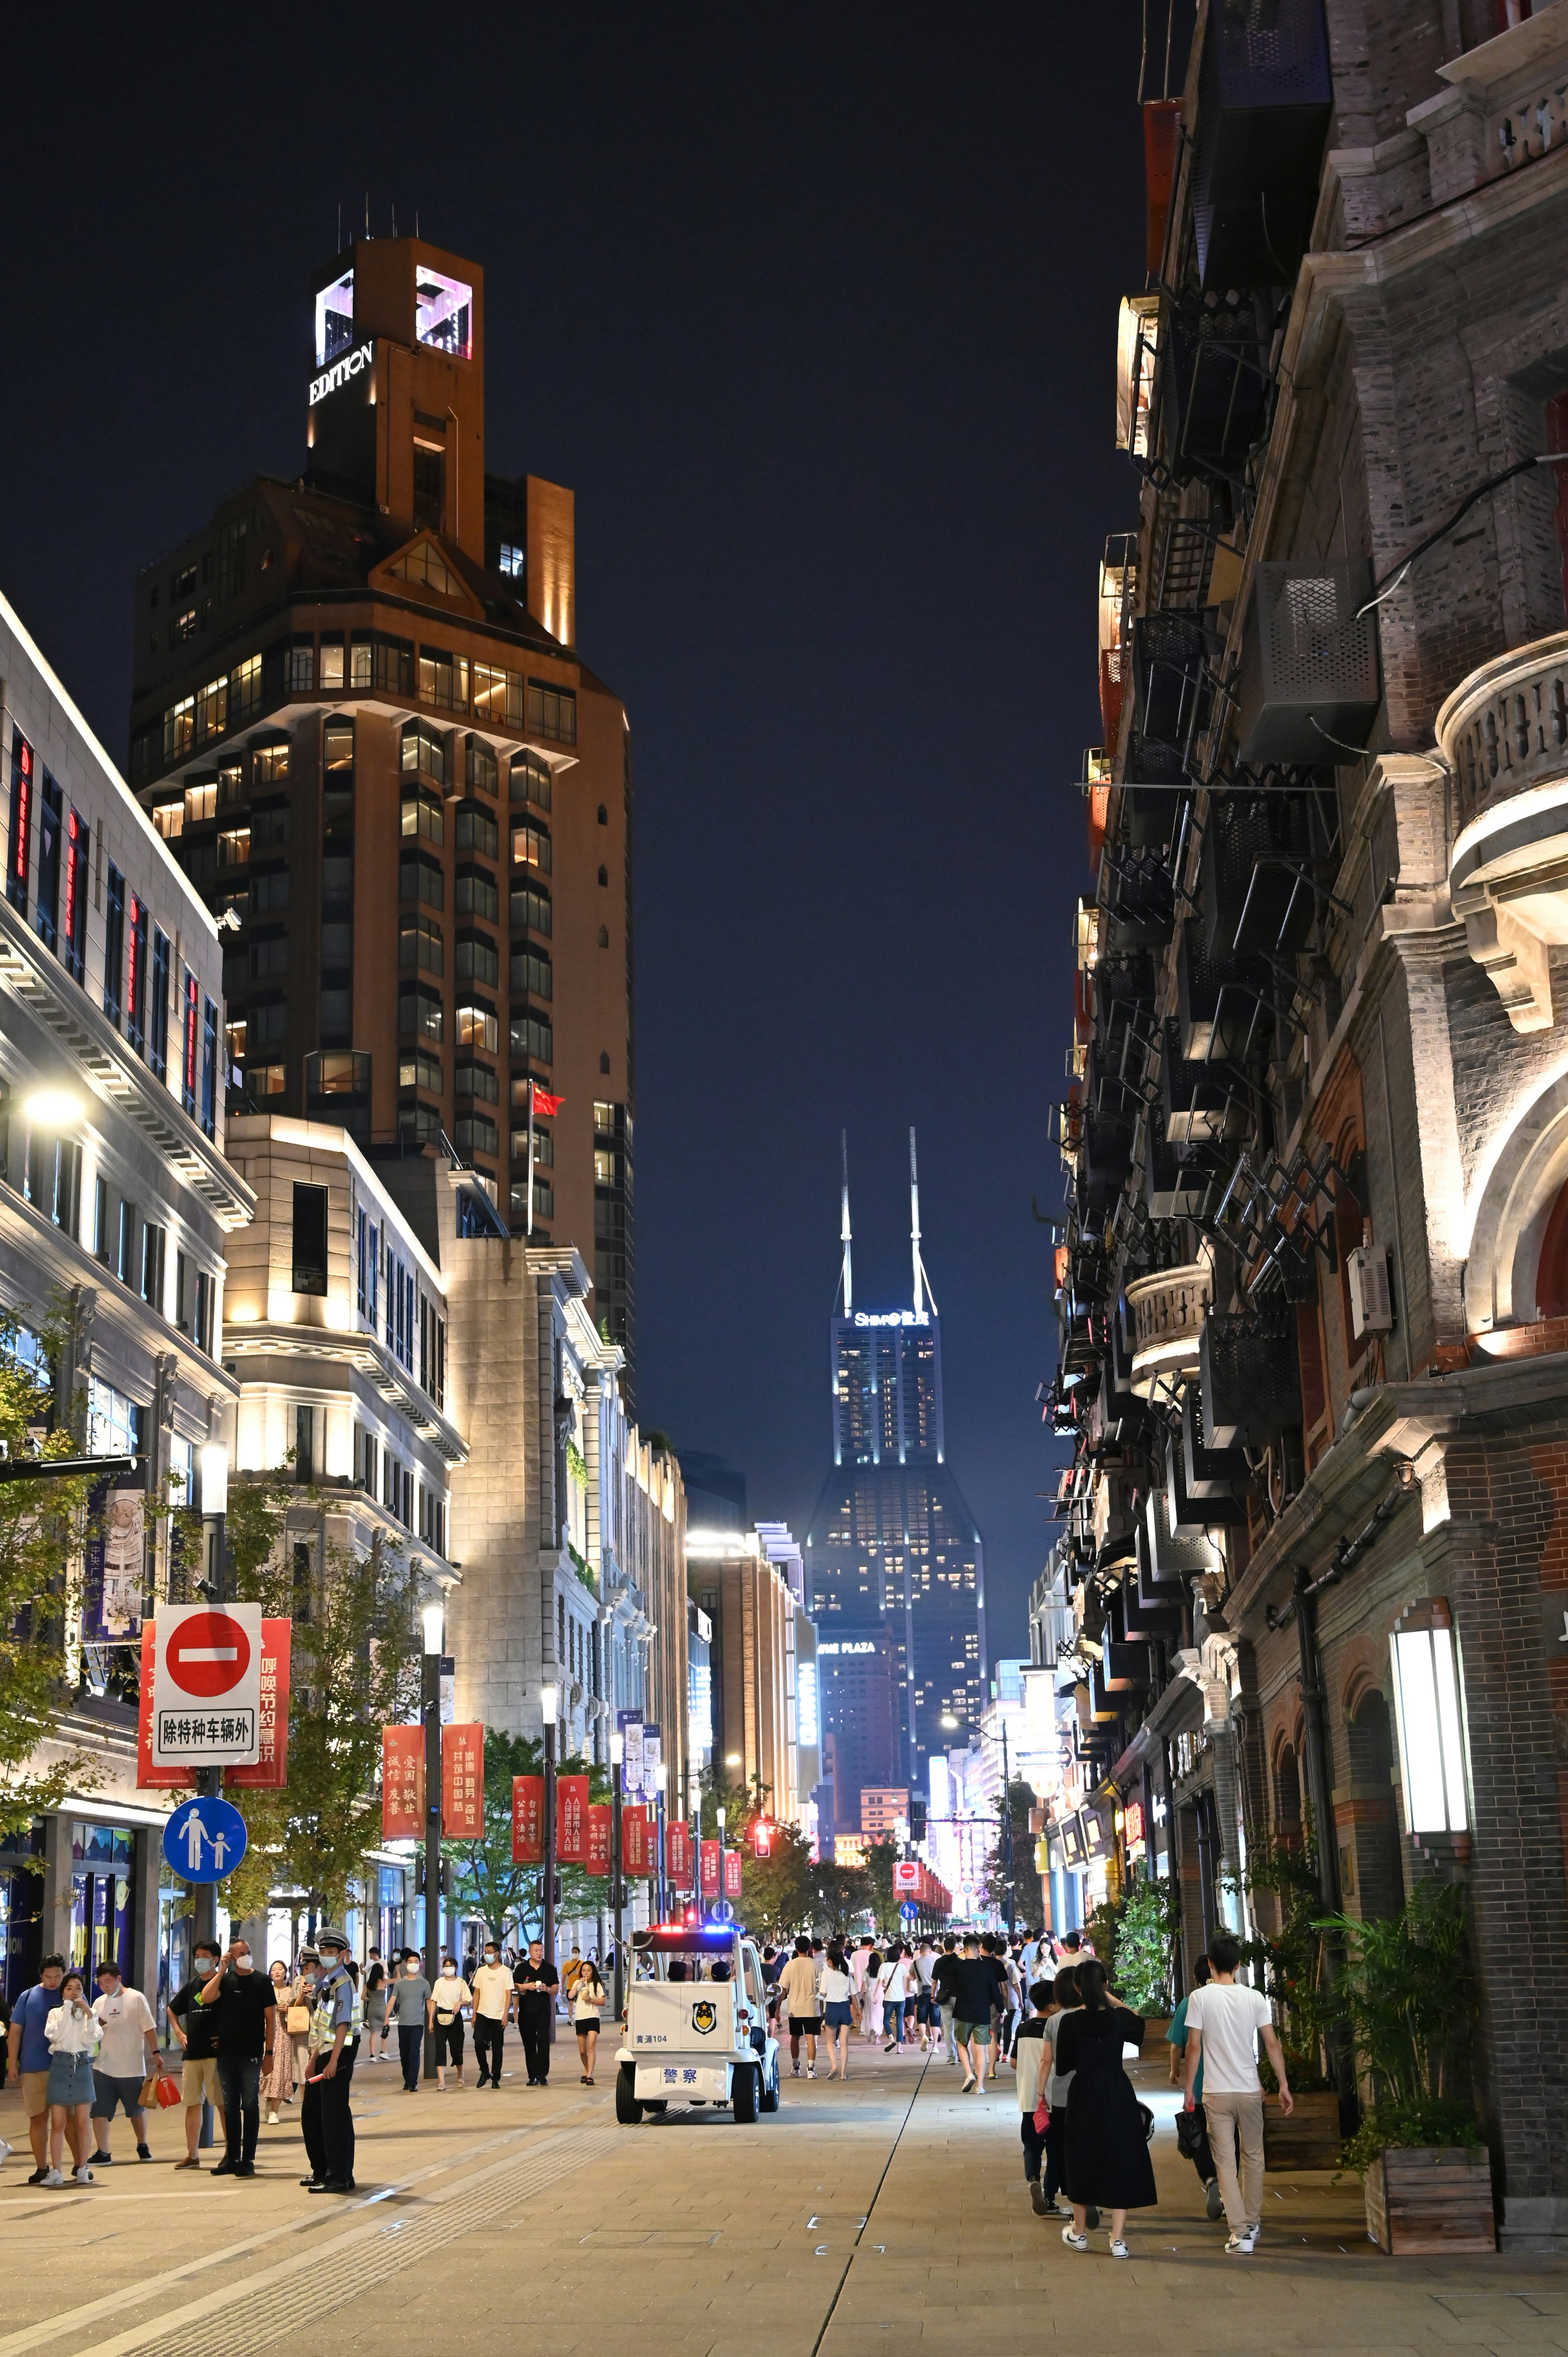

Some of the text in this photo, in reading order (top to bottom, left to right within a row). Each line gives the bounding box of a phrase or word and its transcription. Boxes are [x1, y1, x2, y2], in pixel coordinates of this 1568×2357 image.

[309, 341, 373, 406] EDITION
[842, 1642, 875, 1653] PLAZA
[259, 1657, 277, 1762] 呼唤节约意识
[164, 1717, 249, 1744] 除特种车辆外
[453, 1751, 463, 1812] 共筑中国梦
[636, 2035, 667, 2043] 黄浦104
[664, 2068, 697, 2083] 警察
